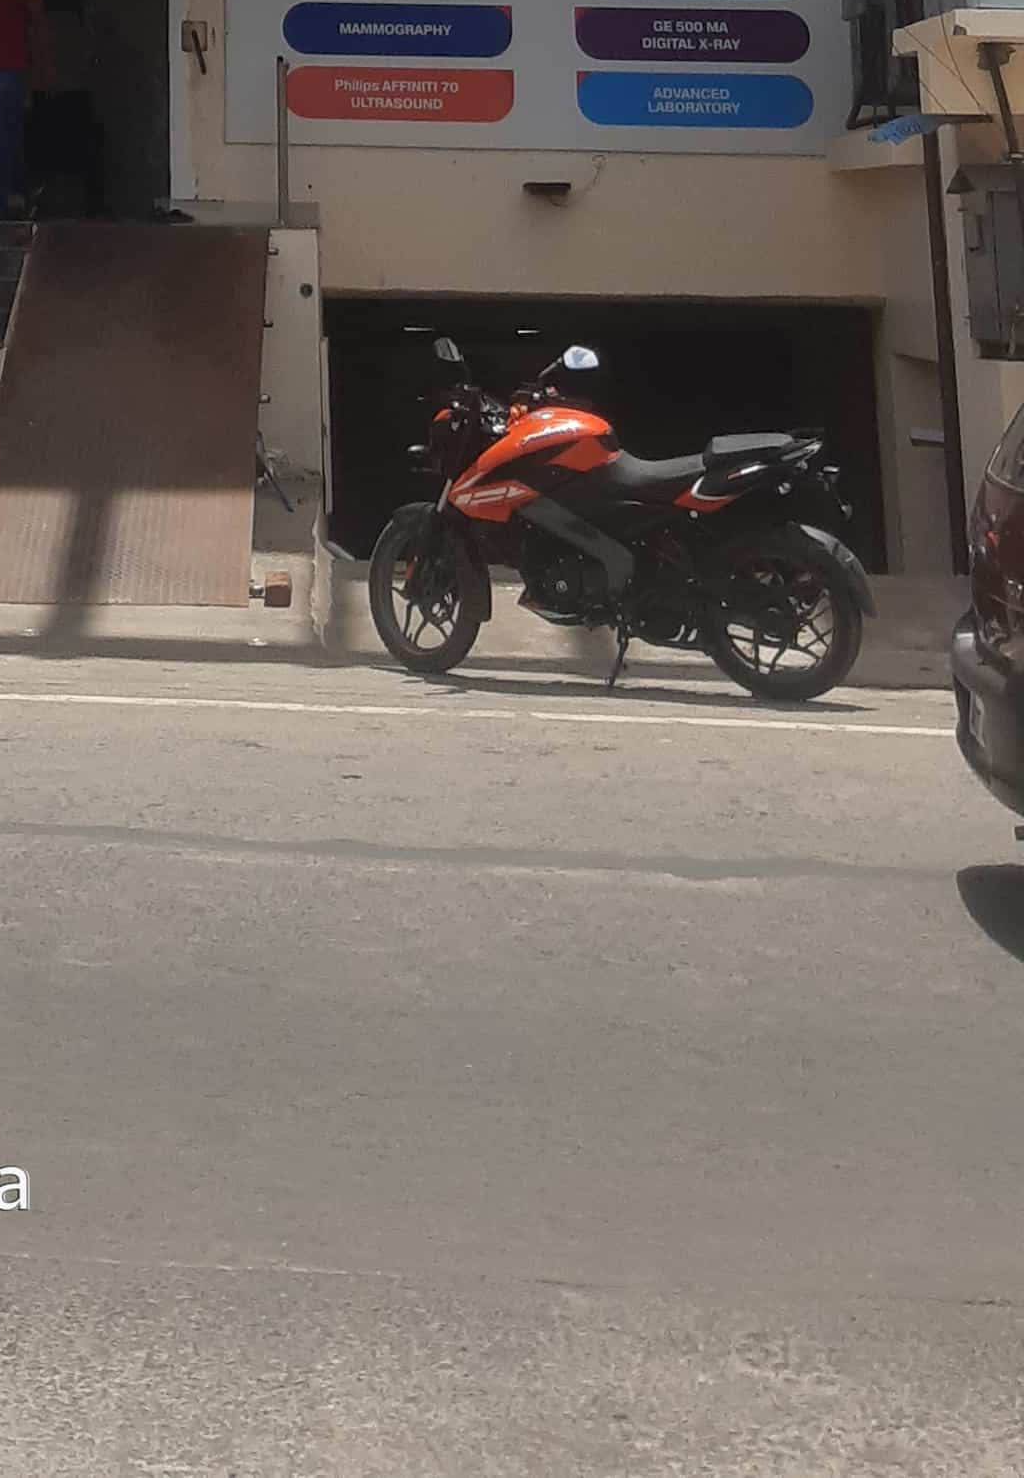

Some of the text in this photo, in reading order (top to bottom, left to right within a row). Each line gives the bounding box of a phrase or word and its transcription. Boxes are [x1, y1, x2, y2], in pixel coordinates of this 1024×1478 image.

[339, 22, 452, 37] MAMMOGRAPHY
[653, 20, 728, 34] GE 500 MA
[642, 37, 741, 51] DIGITAL X-RAY
[334, 79, 459, 95] Philips AFFINITI 70
[653, 87, 731, 101] ADVANCED
[351, 95, 444, 110] ULTRASOUND
[647, 101, 741, 115] LABORATORY
